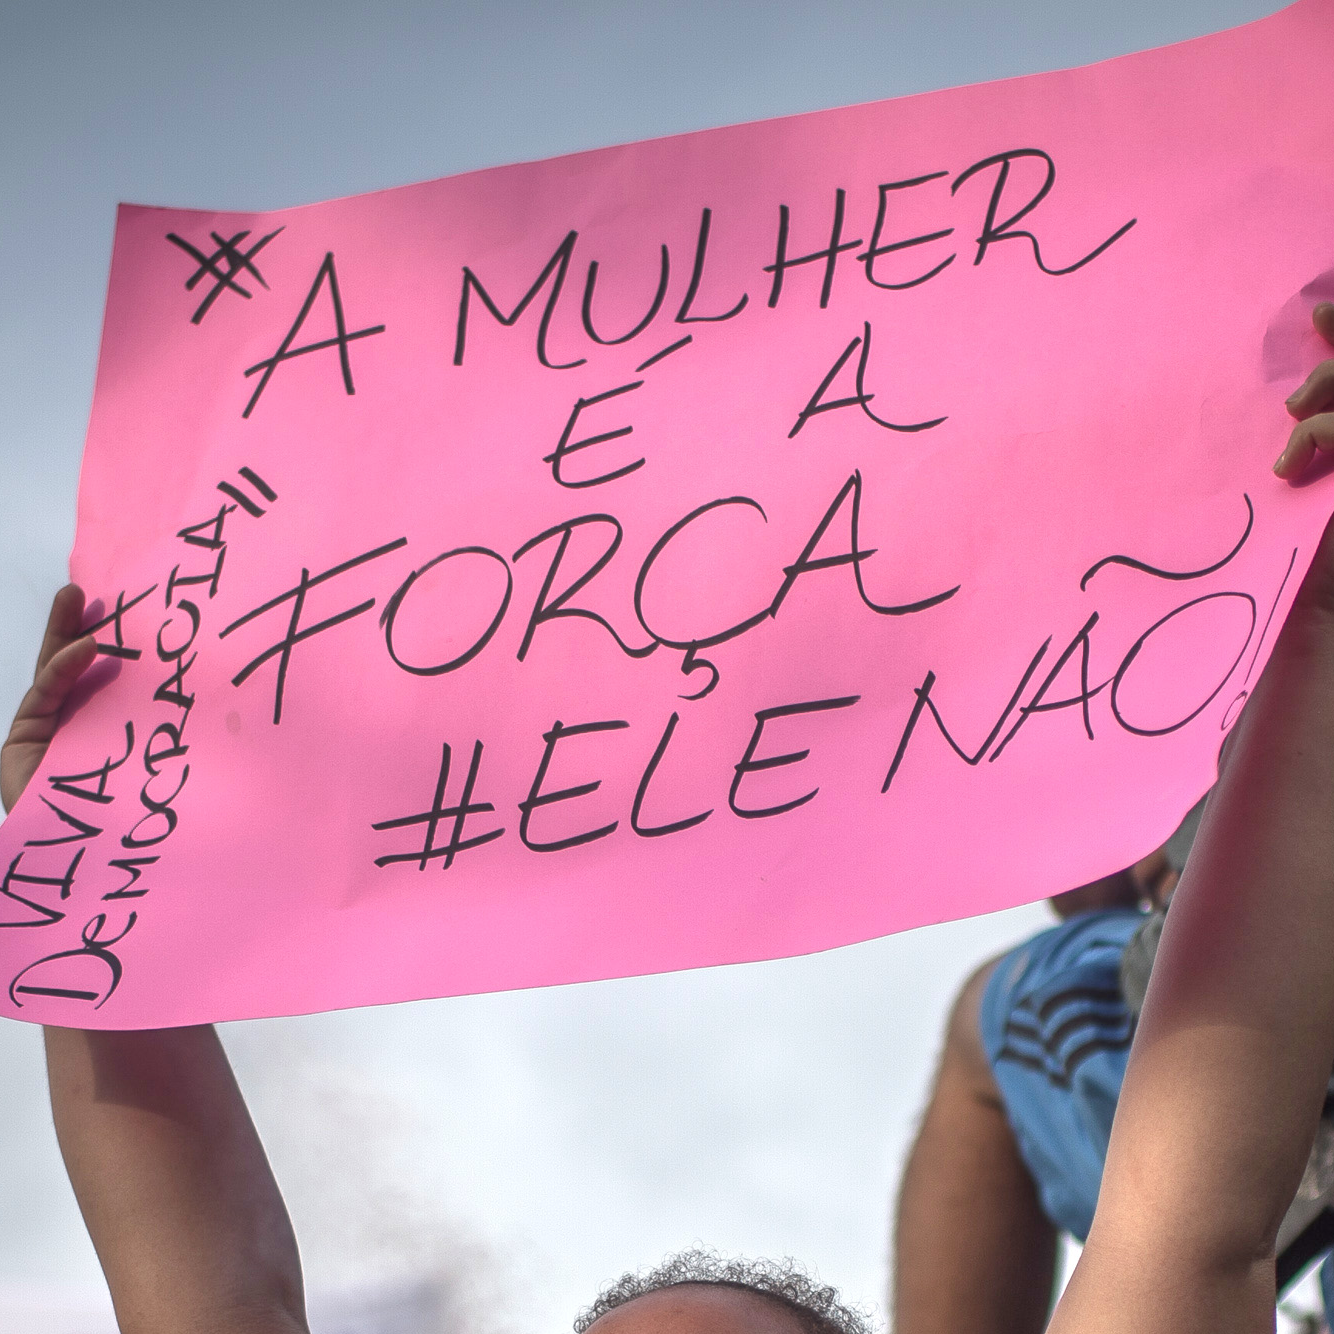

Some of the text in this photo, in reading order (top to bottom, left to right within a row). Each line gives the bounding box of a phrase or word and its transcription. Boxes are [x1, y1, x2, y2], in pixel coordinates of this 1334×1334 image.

[452, 147, 1138, 370] MULHER
[542, 320, 949, 489] É A
[76, 583, 159, 661] A
[218, 468, 962, 726] FORÇA
